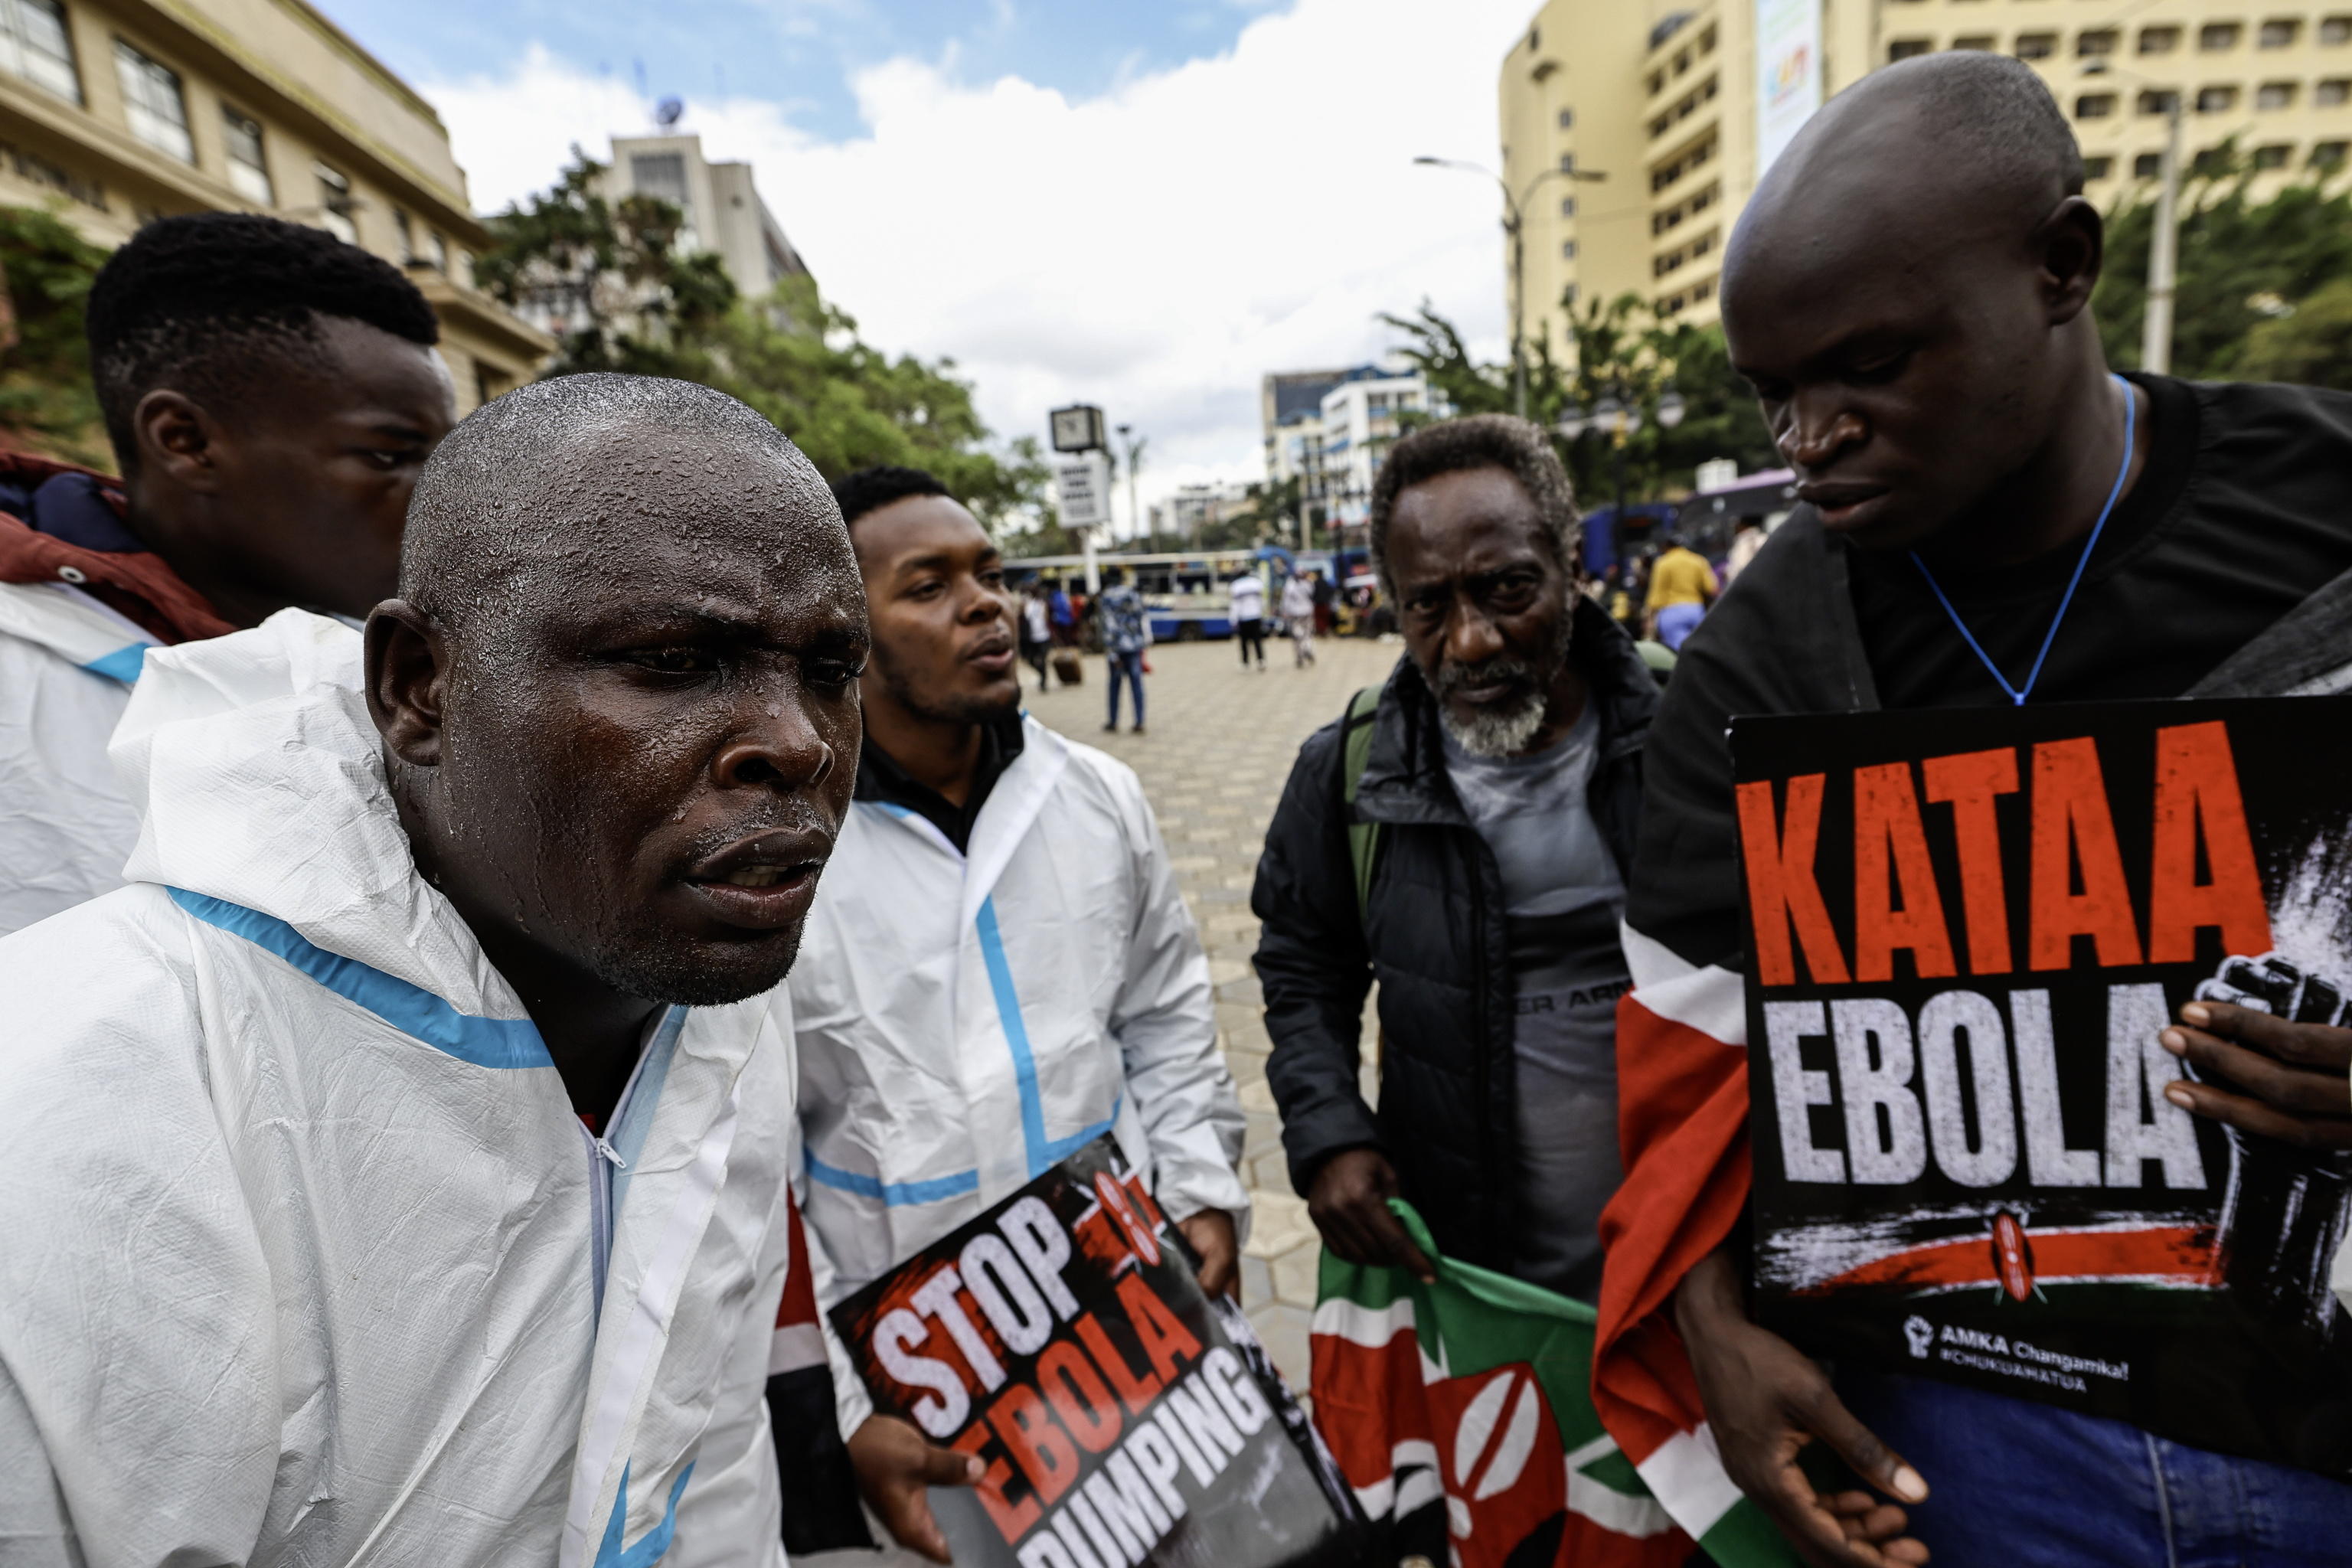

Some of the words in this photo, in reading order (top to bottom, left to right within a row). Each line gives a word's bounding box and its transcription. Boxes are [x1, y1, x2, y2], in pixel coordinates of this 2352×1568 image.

[1735, 720, 2272, 986] KATAA
[1763, 982, 2208, 1190] EBOLA
[872, 1196, 1080, 1438] STOP
[952, 1271, 1203, 1547] EBOLA
[1939, 1324, 2010, 1355] AMKA
[2012, 1341, 2130, 1381] Changamka!
